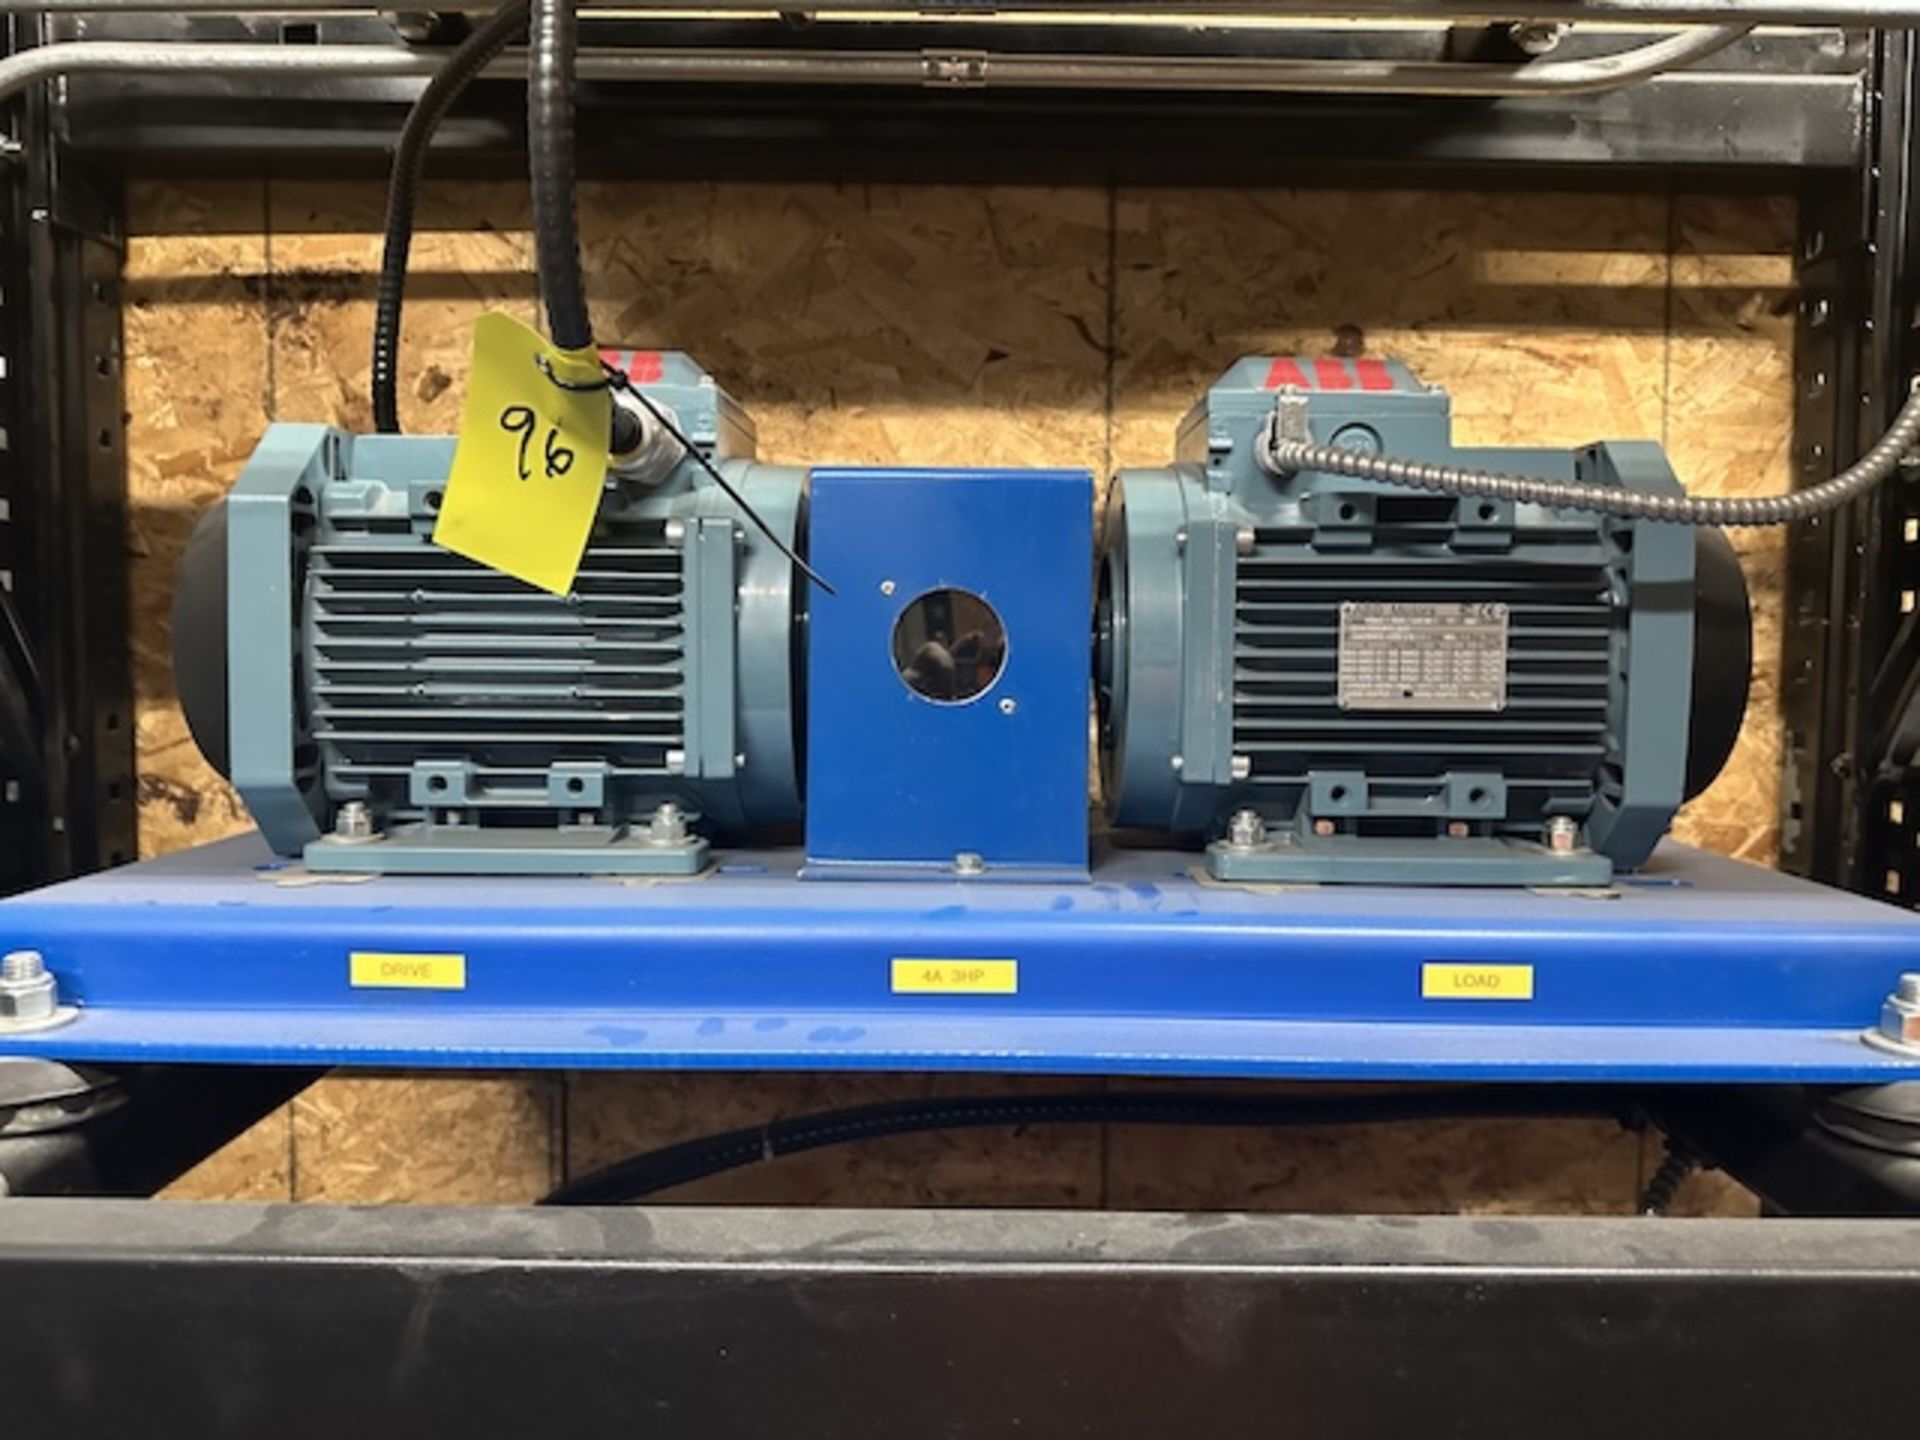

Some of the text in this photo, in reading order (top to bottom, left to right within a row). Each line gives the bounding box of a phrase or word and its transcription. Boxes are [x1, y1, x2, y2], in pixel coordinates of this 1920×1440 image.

[1265, 357, 1396, 391] ABB
[499, 405, 575, 481] 96
[380, 962, 432, 978] DRIVE
[922, 968, 985, 984] 4A 3HP
[1453, 973, 1501, 988] LOAD
